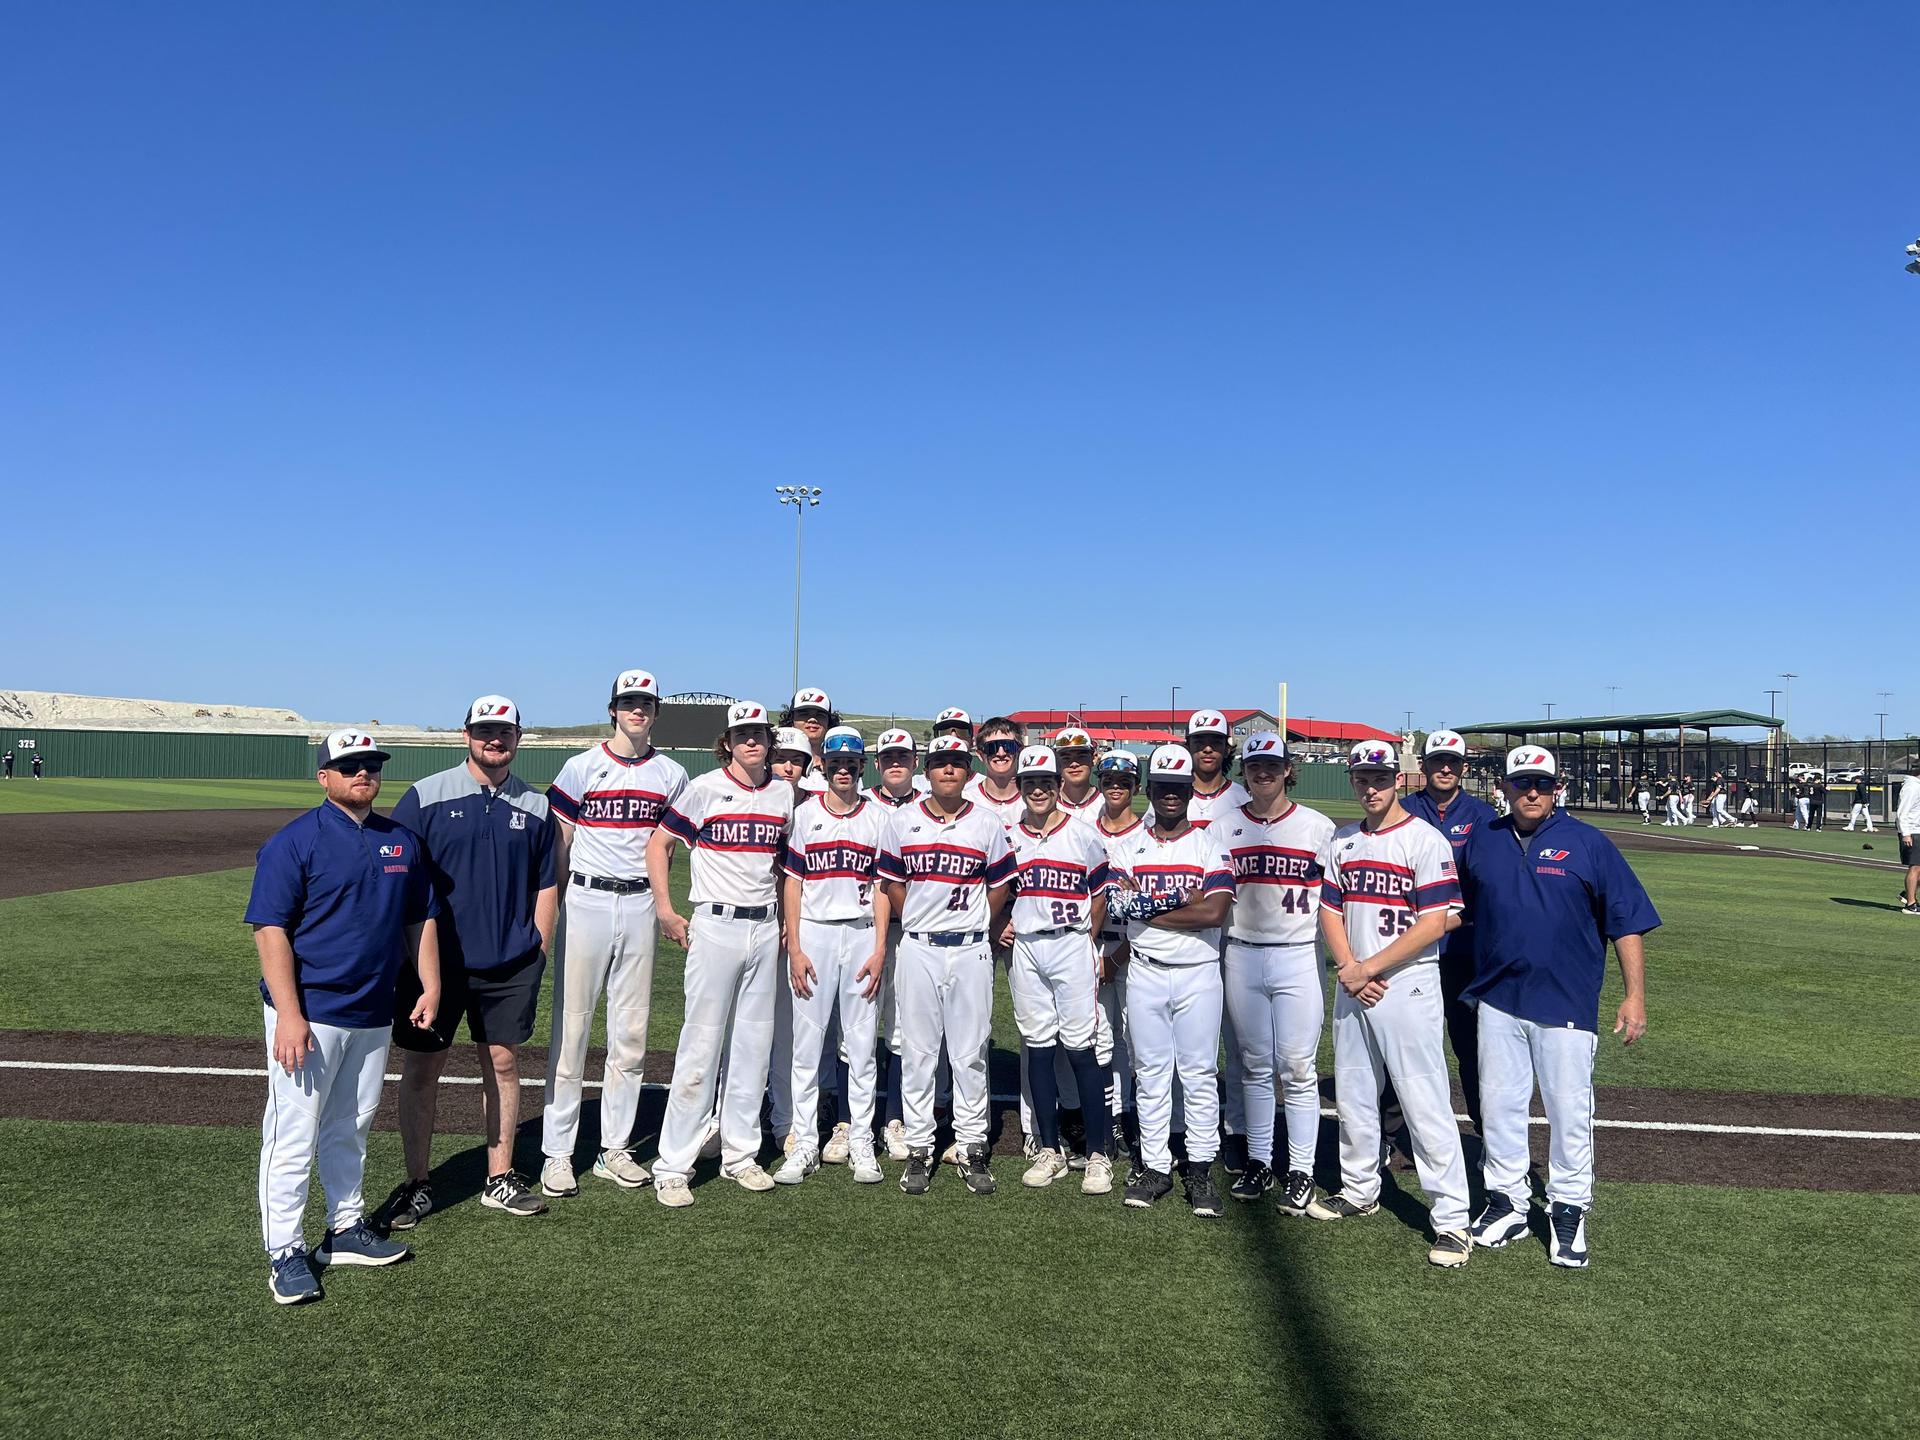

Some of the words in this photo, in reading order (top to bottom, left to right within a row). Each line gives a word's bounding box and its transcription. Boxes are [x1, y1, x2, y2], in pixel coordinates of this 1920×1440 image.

[662, 697, 694, 705] MELISSA
[696, 697, 738, 706] CARDINALS
[18, 739, 36, 749] 375
[711, 823, 750, 843] UME
[804, 849, 838, 872] UME
[903, 852, 936, 876] UME
[936, 852, 983, 877] PREP
[1233, 855, 1260, 877] ME
[1264, 855, 1310, 878] PREP
[1536, 865, 1567, 877] BASEBALL
[1039, 867, 1081, 891] PREP
[1363, 870, 1414, 896] PREP
[946, 886, 970, 912] 21
[1281, 887, 1311, 915] 44
[1050, 900, 1083, 926] 22
[1377, 907, 1415, 938] 35
